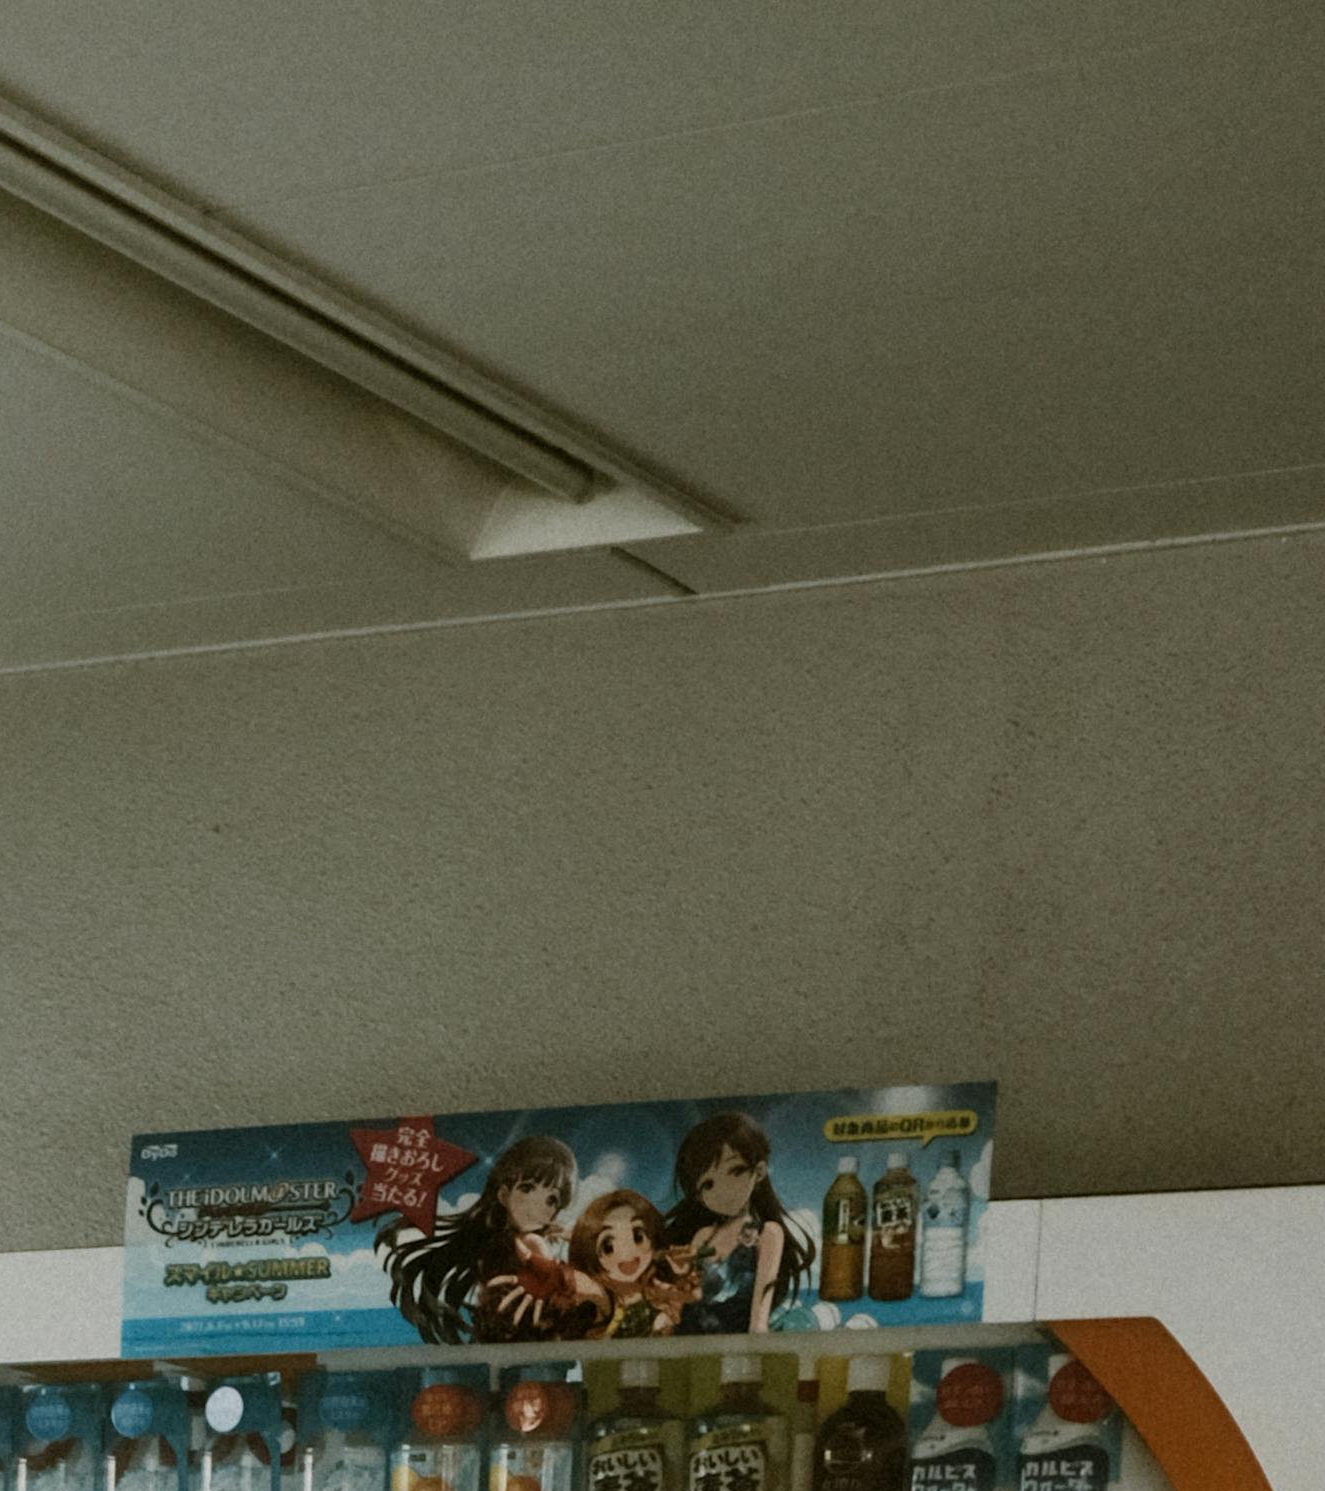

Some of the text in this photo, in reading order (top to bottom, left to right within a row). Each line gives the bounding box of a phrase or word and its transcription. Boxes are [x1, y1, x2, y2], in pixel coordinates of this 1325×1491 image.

[397, 1126, 431, 1149] 完全
[370, 1143, 444, 1172] 描きおろし
[168, 1190, 201, 1208] THE
[593, 1453, 656, 1473] おいしい
[693, 1450, 758, 1473] おいしい
[1024, 1461, 1094, 1478] カルピス
[913, 1463, 976, 1481] カルピス
